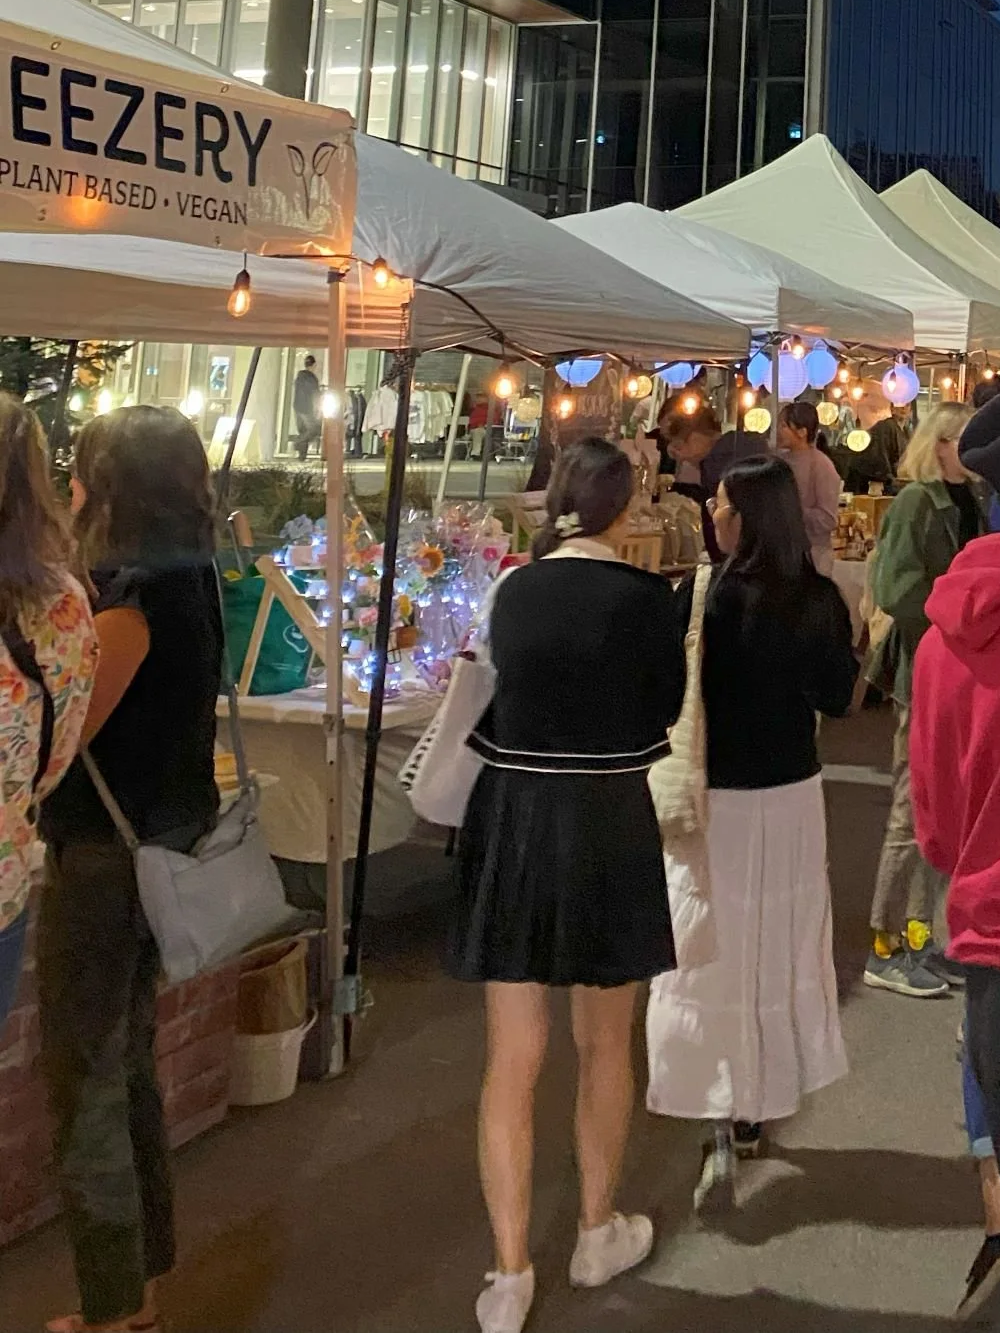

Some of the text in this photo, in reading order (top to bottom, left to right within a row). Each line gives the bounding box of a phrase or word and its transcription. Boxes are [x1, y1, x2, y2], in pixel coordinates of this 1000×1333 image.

[10, 55, 272, 187] EEZERY
[0, 158, 249, 226] PLANT BASED VEGAN
